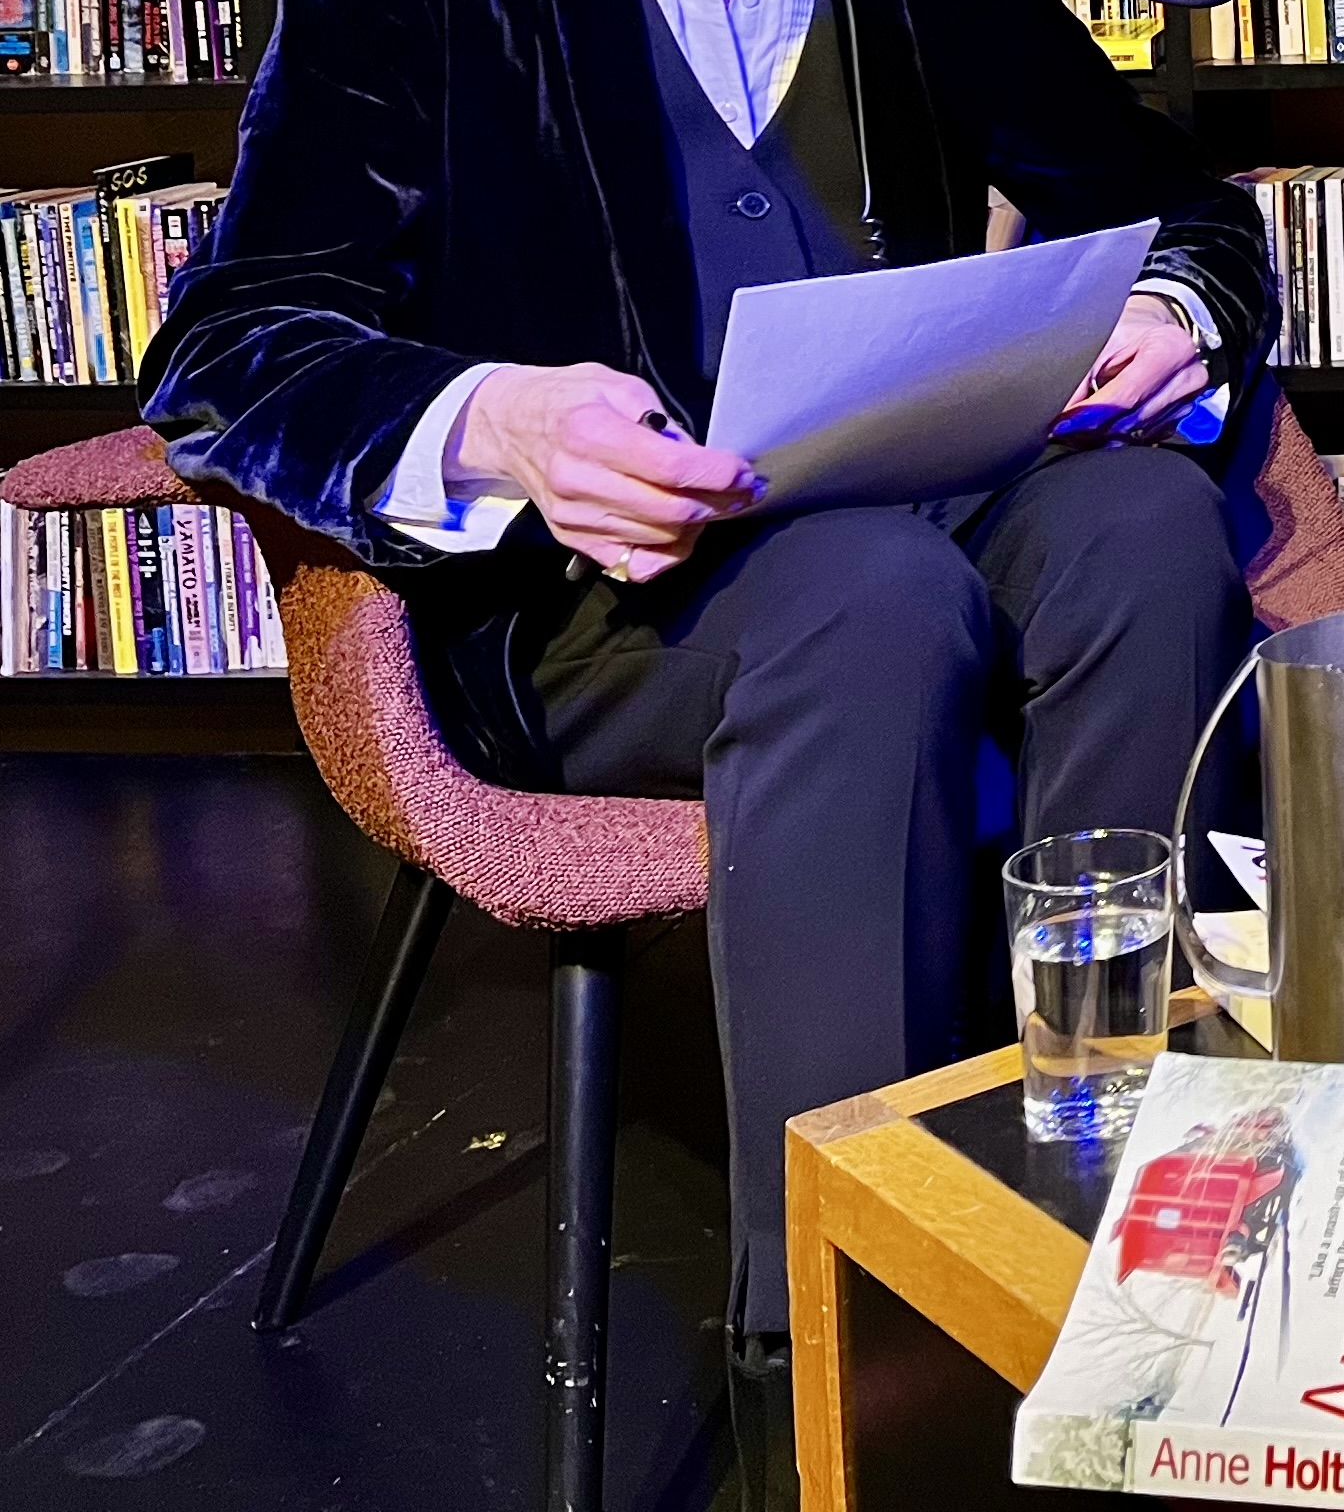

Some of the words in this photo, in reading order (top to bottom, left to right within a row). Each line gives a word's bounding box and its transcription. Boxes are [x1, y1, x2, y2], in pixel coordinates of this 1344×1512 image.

[110, 166, 148, 192] SOS
[64, 216, 72, 234] THE
[66, 236, 76, 283] PRIMITIVE
[178, 519, 197, 590] YAMATO
[1150, 1437, 1250, 1485] Anne
